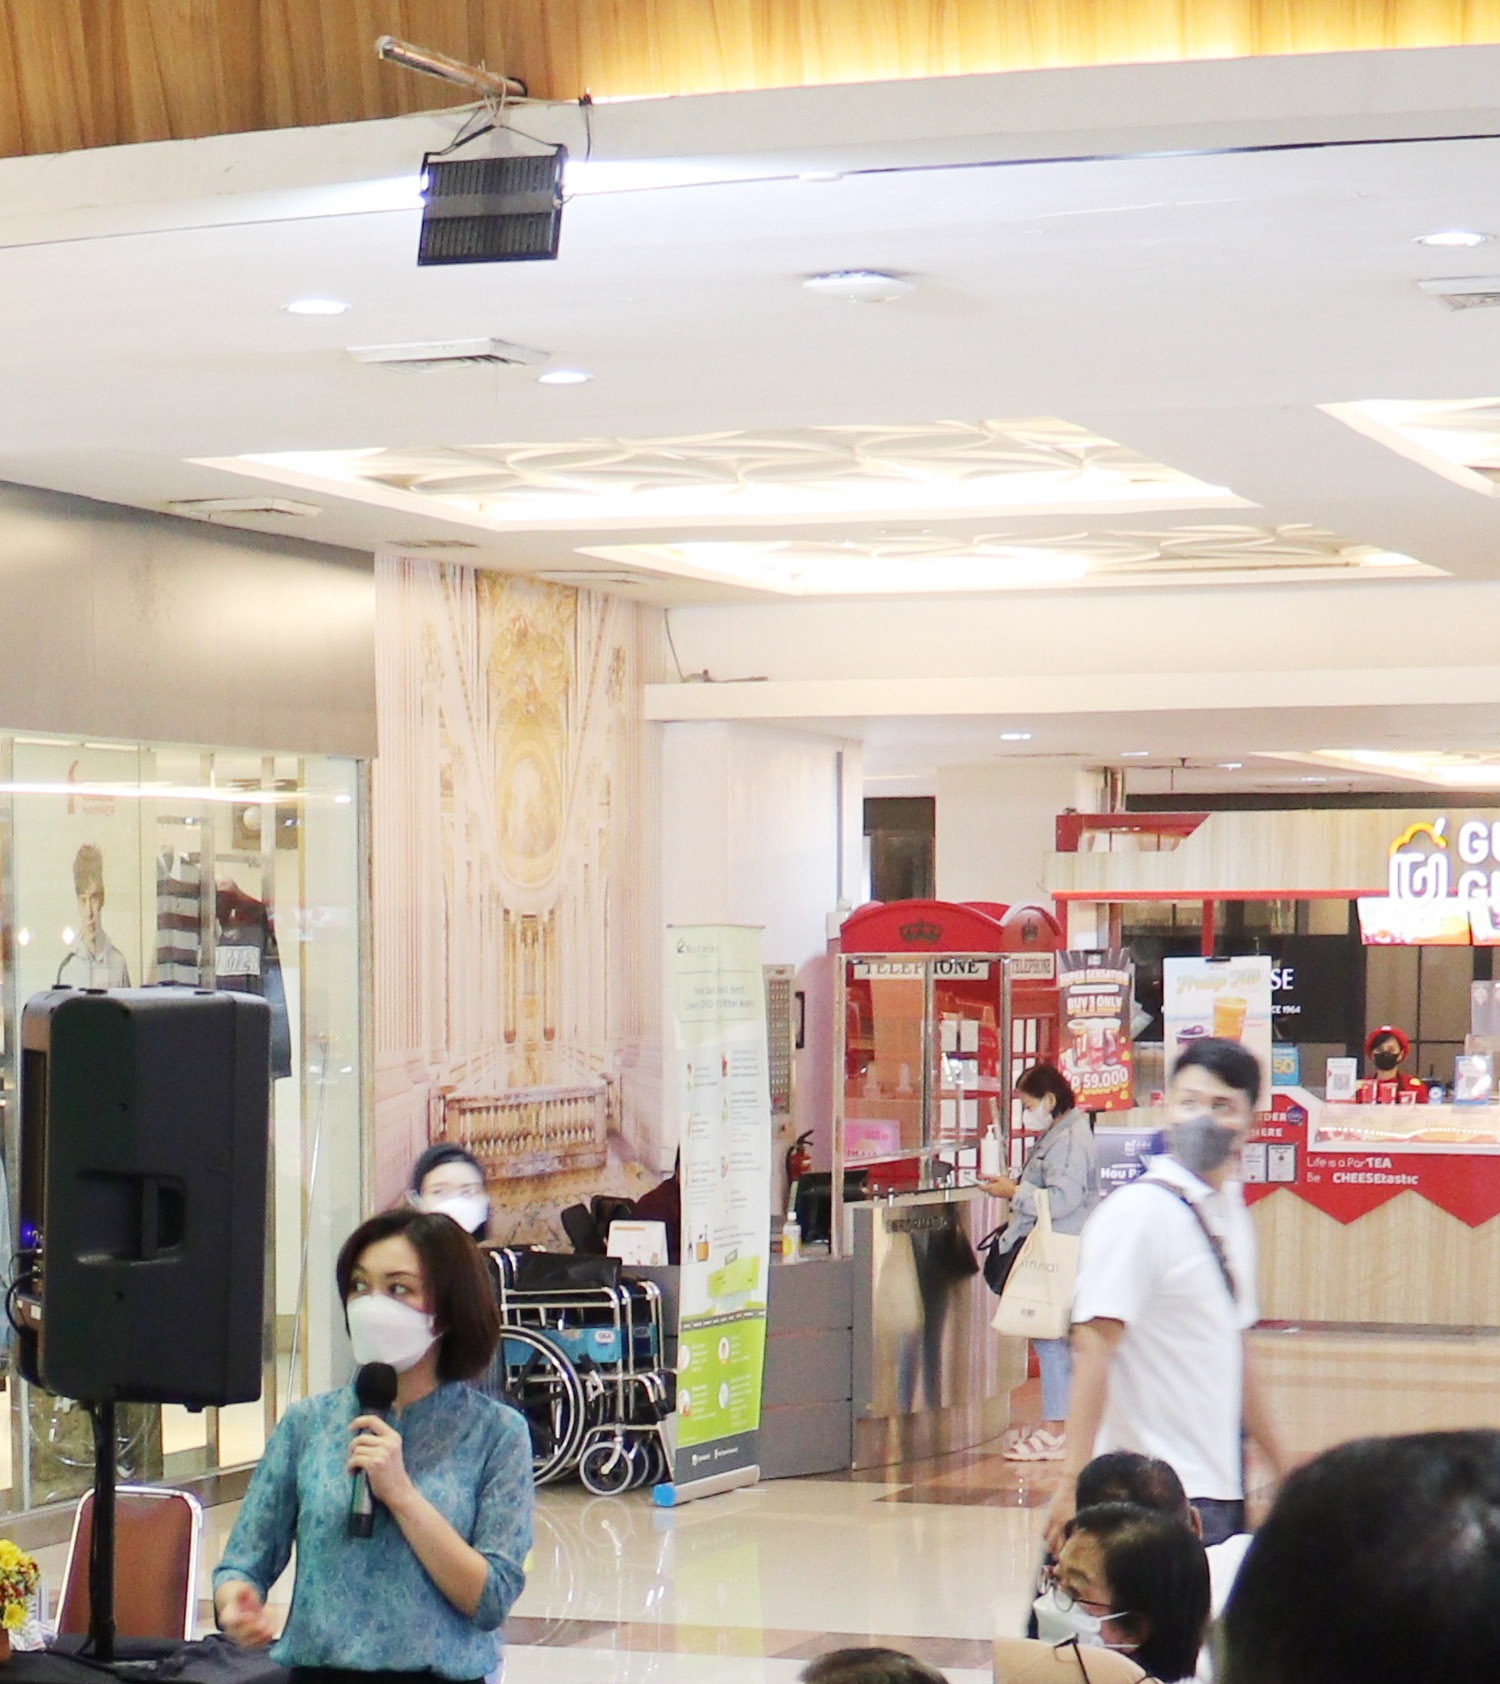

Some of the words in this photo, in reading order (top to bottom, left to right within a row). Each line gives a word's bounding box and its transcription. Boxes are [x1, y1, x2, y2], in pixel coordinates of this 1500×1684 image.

[865, 960, 979, 975] TELEPONE
[1067, 996, 1088, 1011] BUY
[1096, 995, 1123, 1011] ONLY
[1083, 1067, 1129, 1089] 59.000
[1306, 1156, 1326, 1168] Life
[1306, 1172, 1321, 1183] Be
[1332, 1171, 1420, 1185] CHEESEtastic
